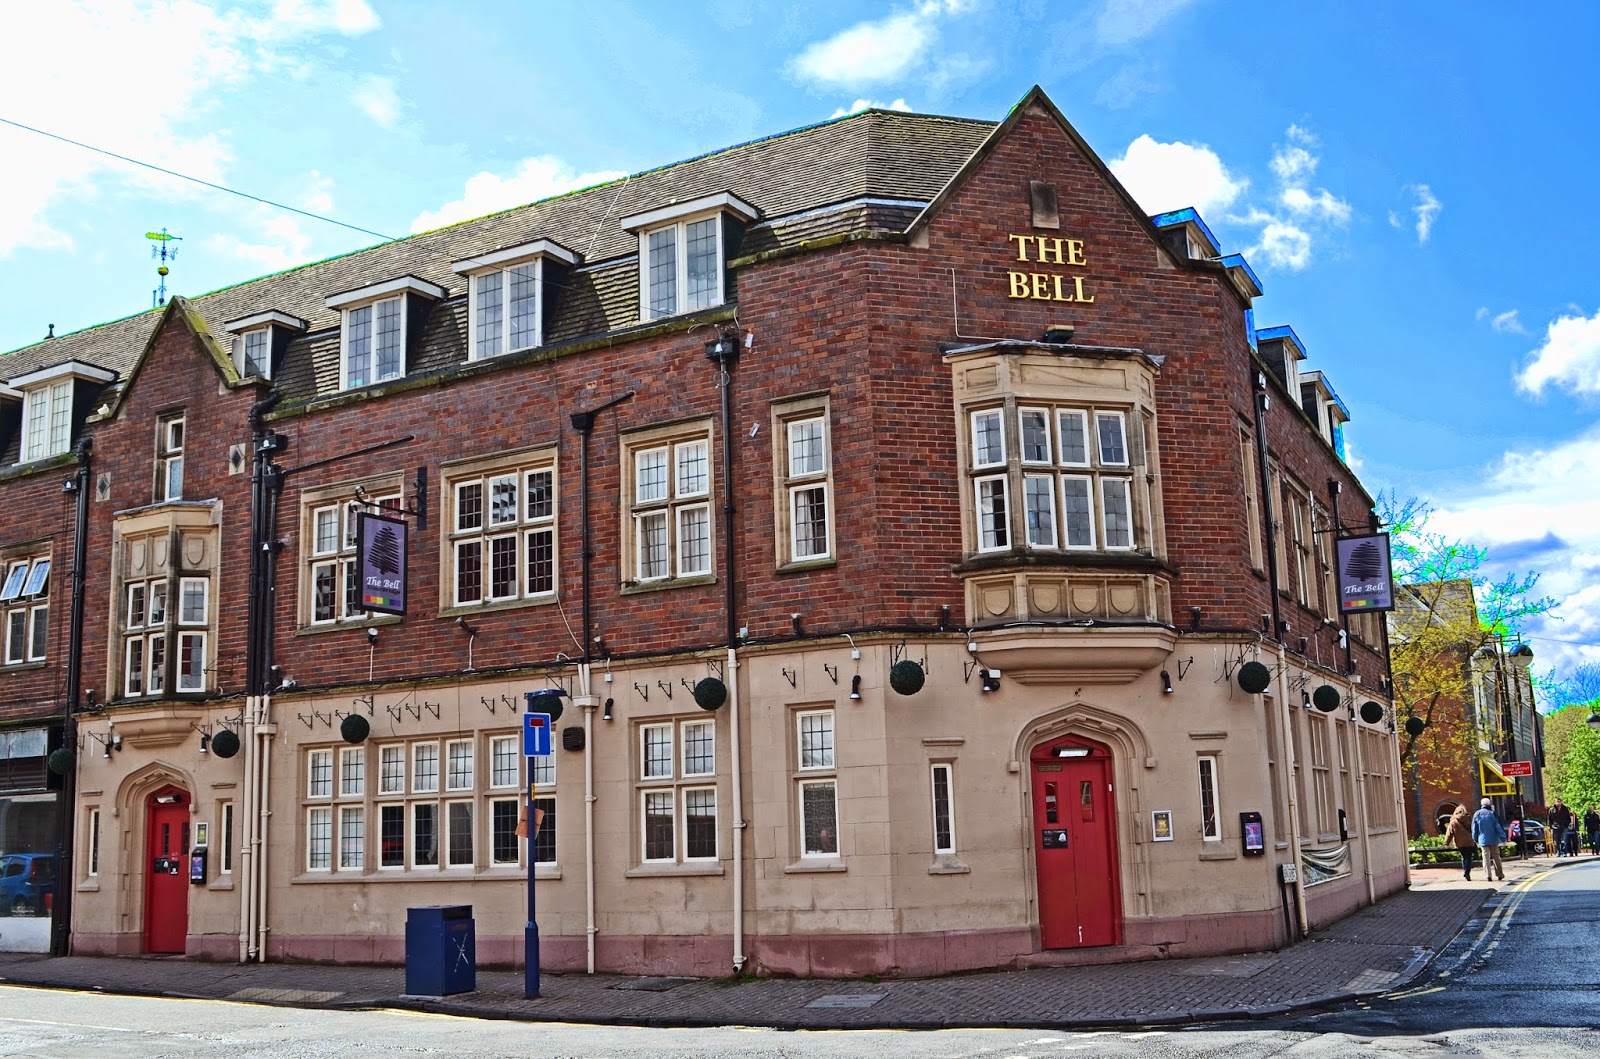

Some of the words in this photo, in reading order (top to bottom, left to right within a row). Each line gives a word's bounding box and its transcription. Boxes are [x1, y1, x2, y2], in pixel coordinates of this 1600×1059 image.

[1009, 233, 1087, 266] THE
[1007, 271, 1095, 303] BELL
[366, 576, 381, 586] The
[383, 579, 401, 589] Bell
[1344, 584, 1362, 594] The
[1364, 582, 1386, 592] Bell
